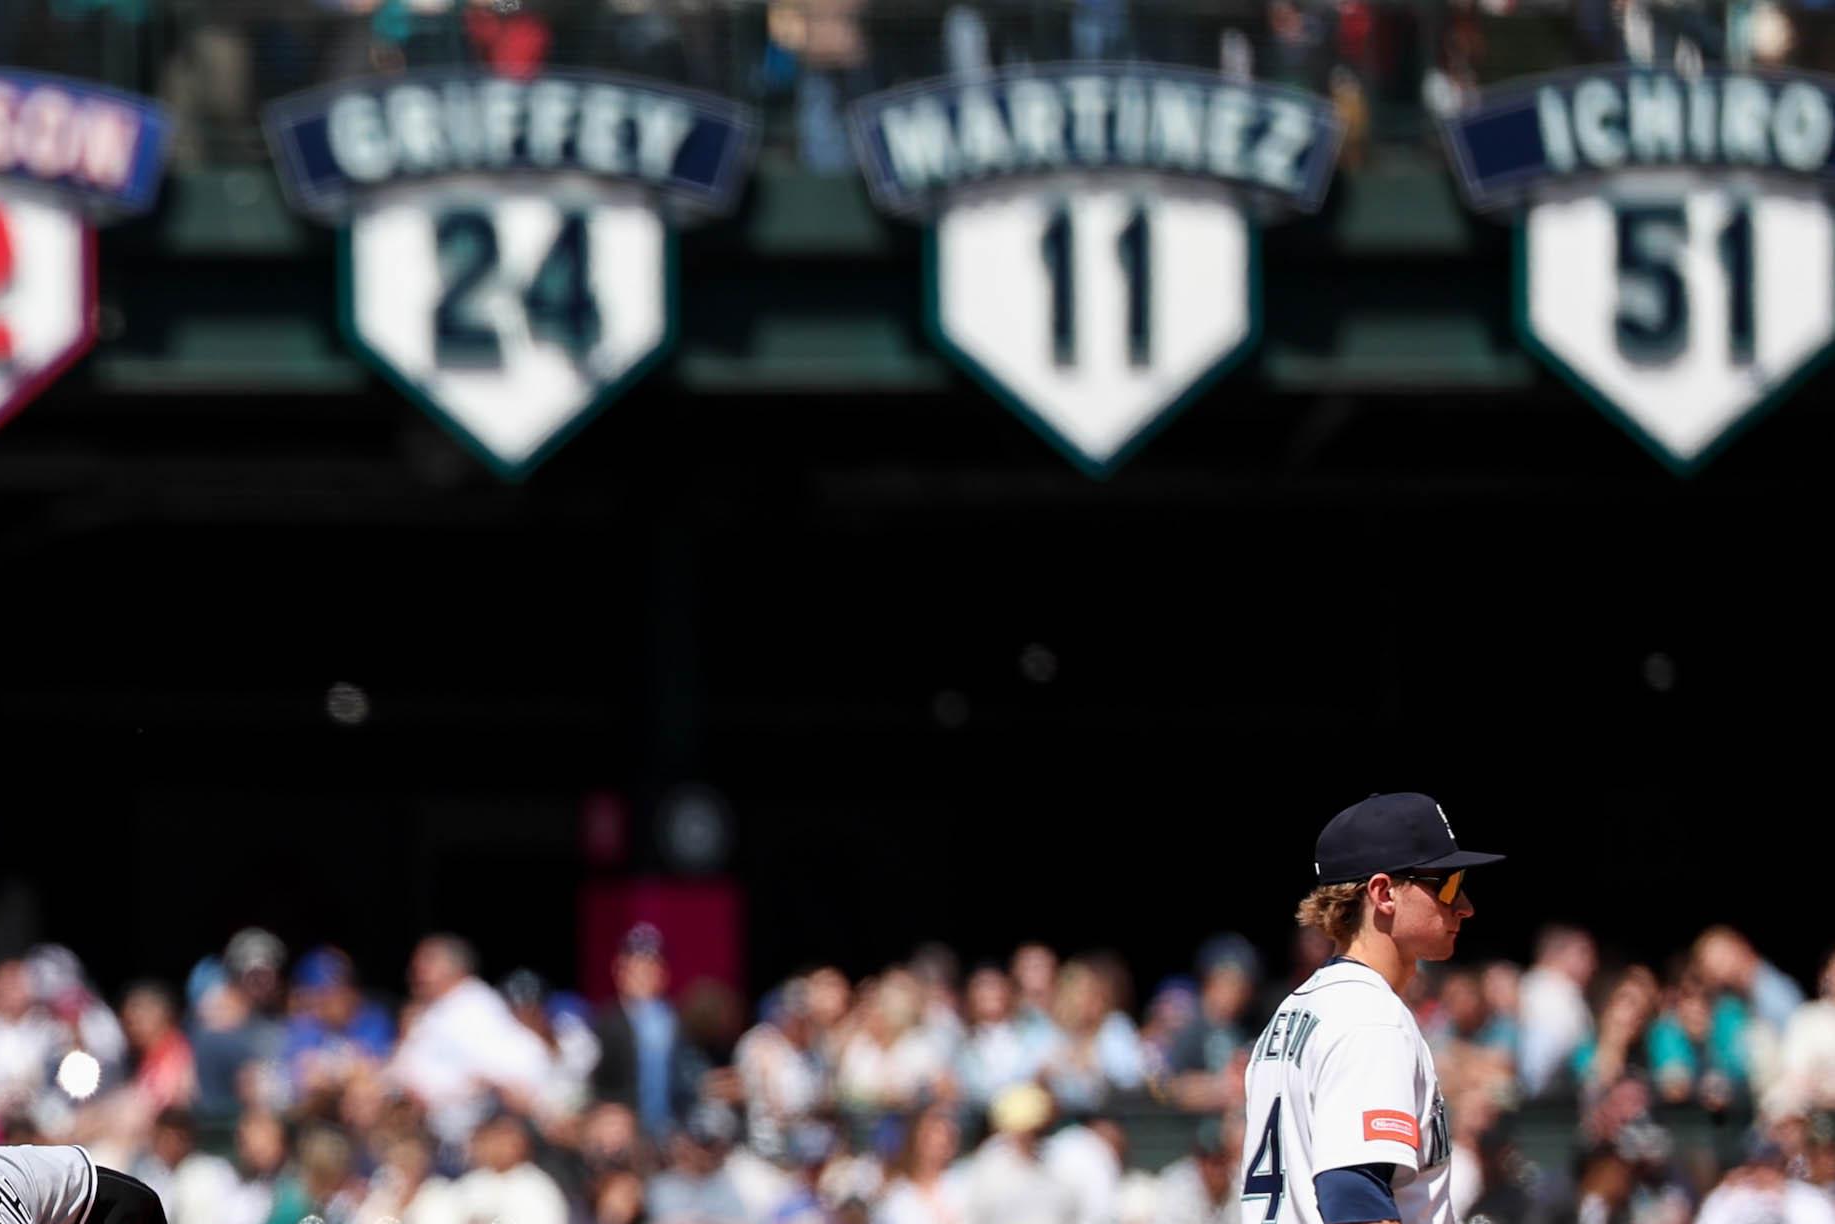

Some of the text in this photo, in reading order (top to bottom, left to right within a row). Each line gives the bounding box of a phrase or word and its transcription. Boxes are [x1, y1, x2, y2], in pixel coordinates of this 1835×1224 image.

[327, 80, 692, 182] GRIFFEY
[879, 74, 1312, 192] MARTINEZ
[1536, 75, 1834, 173] ICHIRO
[434, 203, 602, 374] 24
[1041, 207, 1152, 370] 11
[1612, 202, 1758, 373] 51
